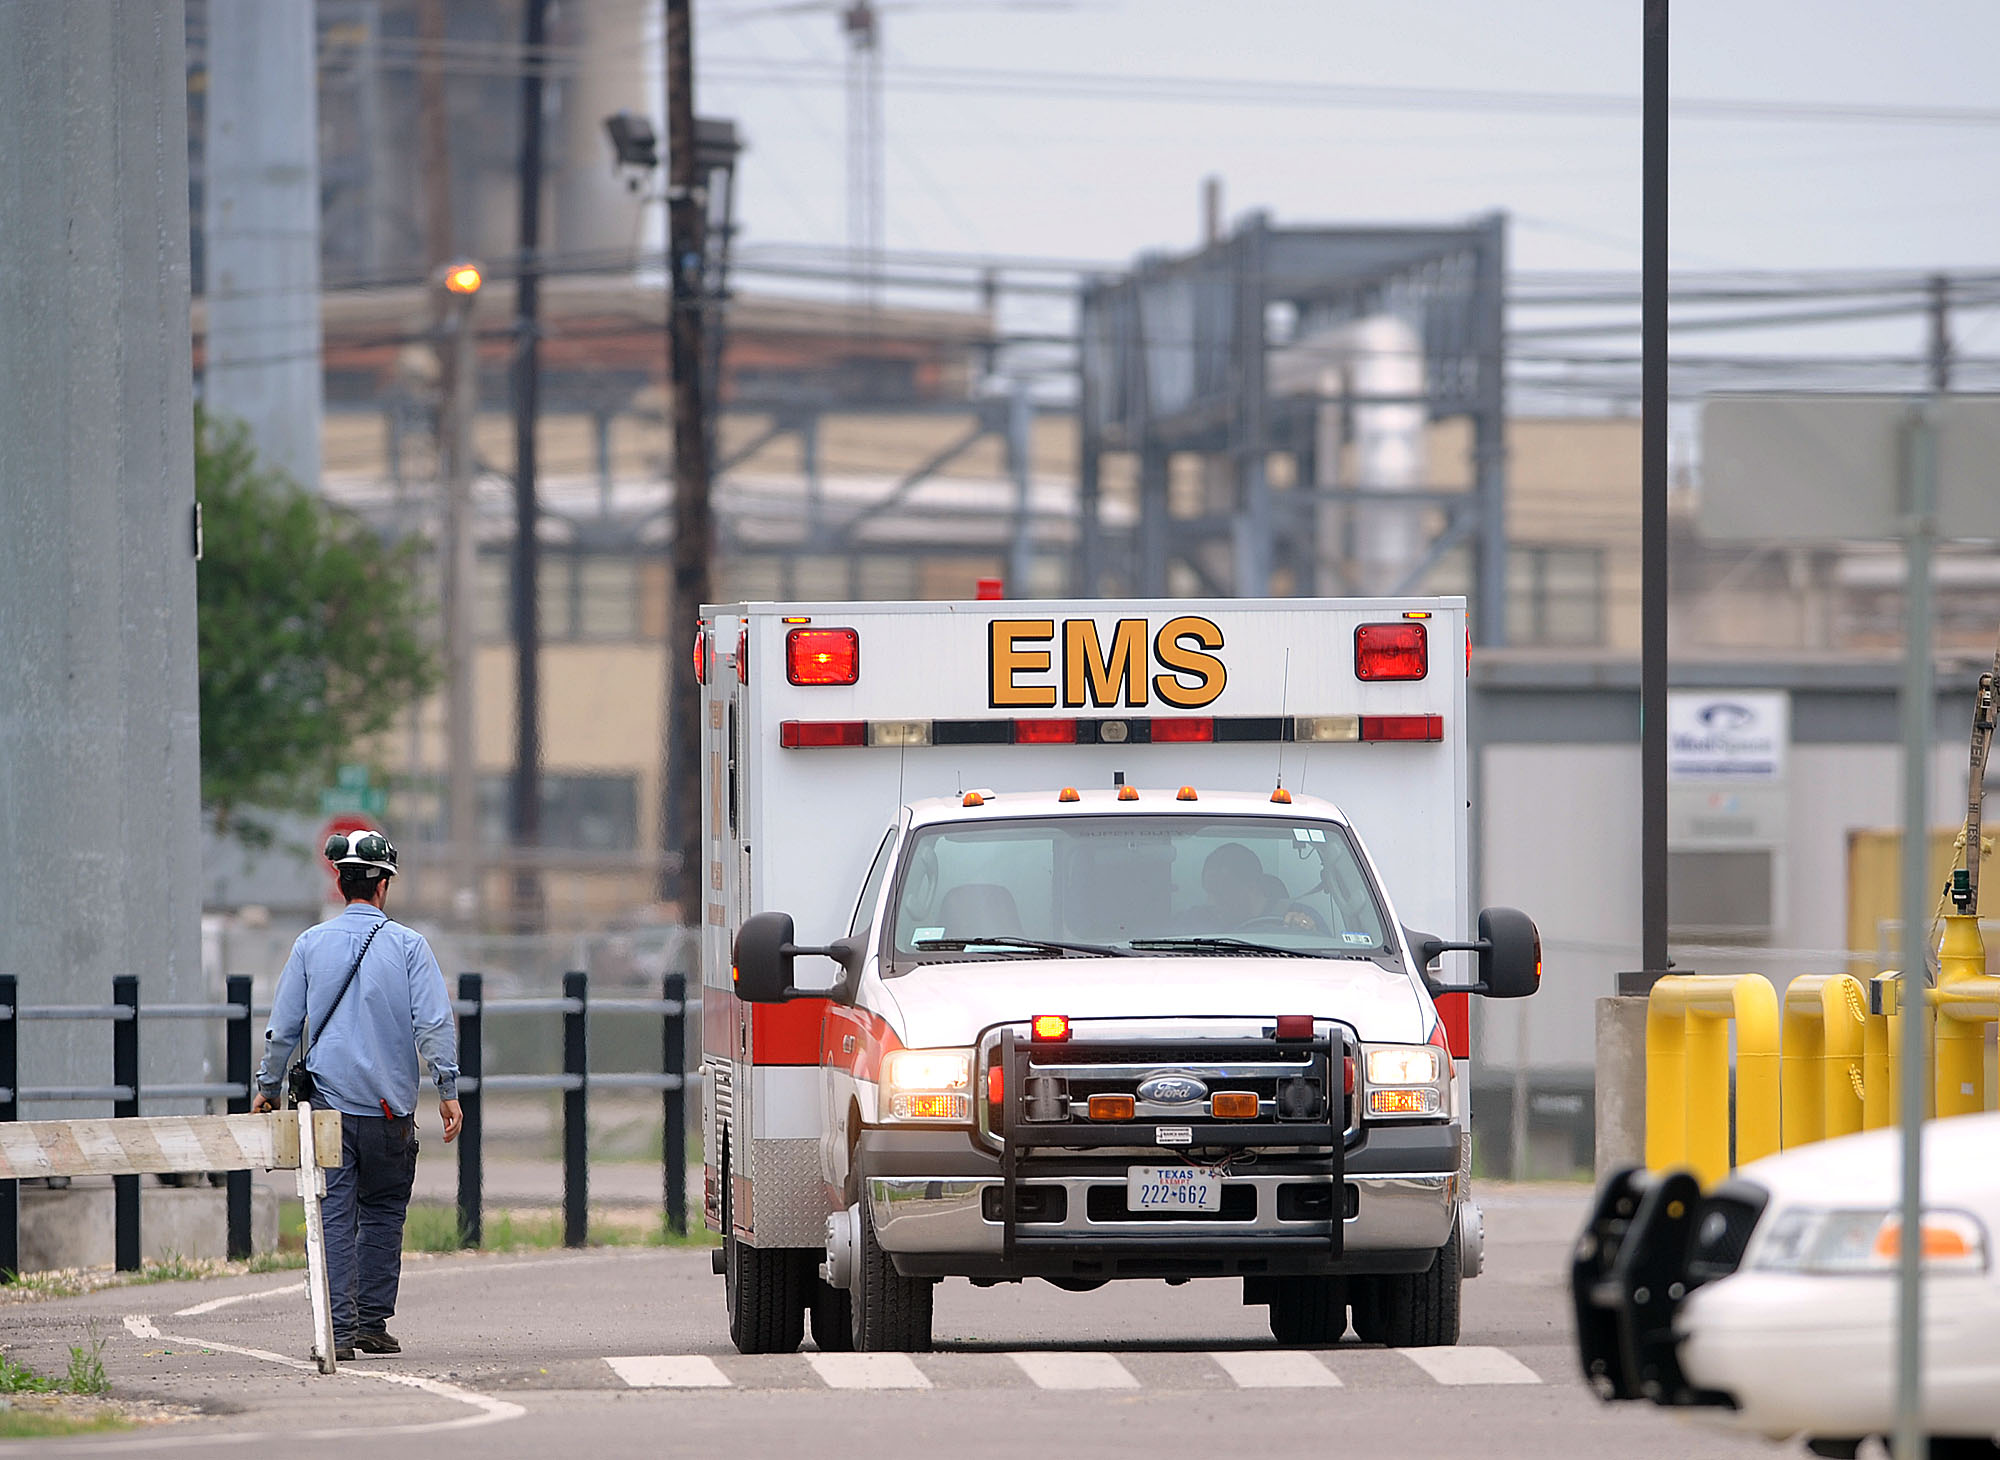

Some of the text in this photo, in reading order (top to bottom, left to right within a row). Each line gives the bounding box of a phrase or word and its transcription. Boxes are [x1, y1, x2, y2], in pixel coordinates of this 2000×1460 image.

[988, 616, 1228, 709] EMS
[1968, 803, 1979, 848] HI TEST
[1154, 1081, 1191, 1098] Ford
[1157, 1170, 1194, 1179] TEXAS
